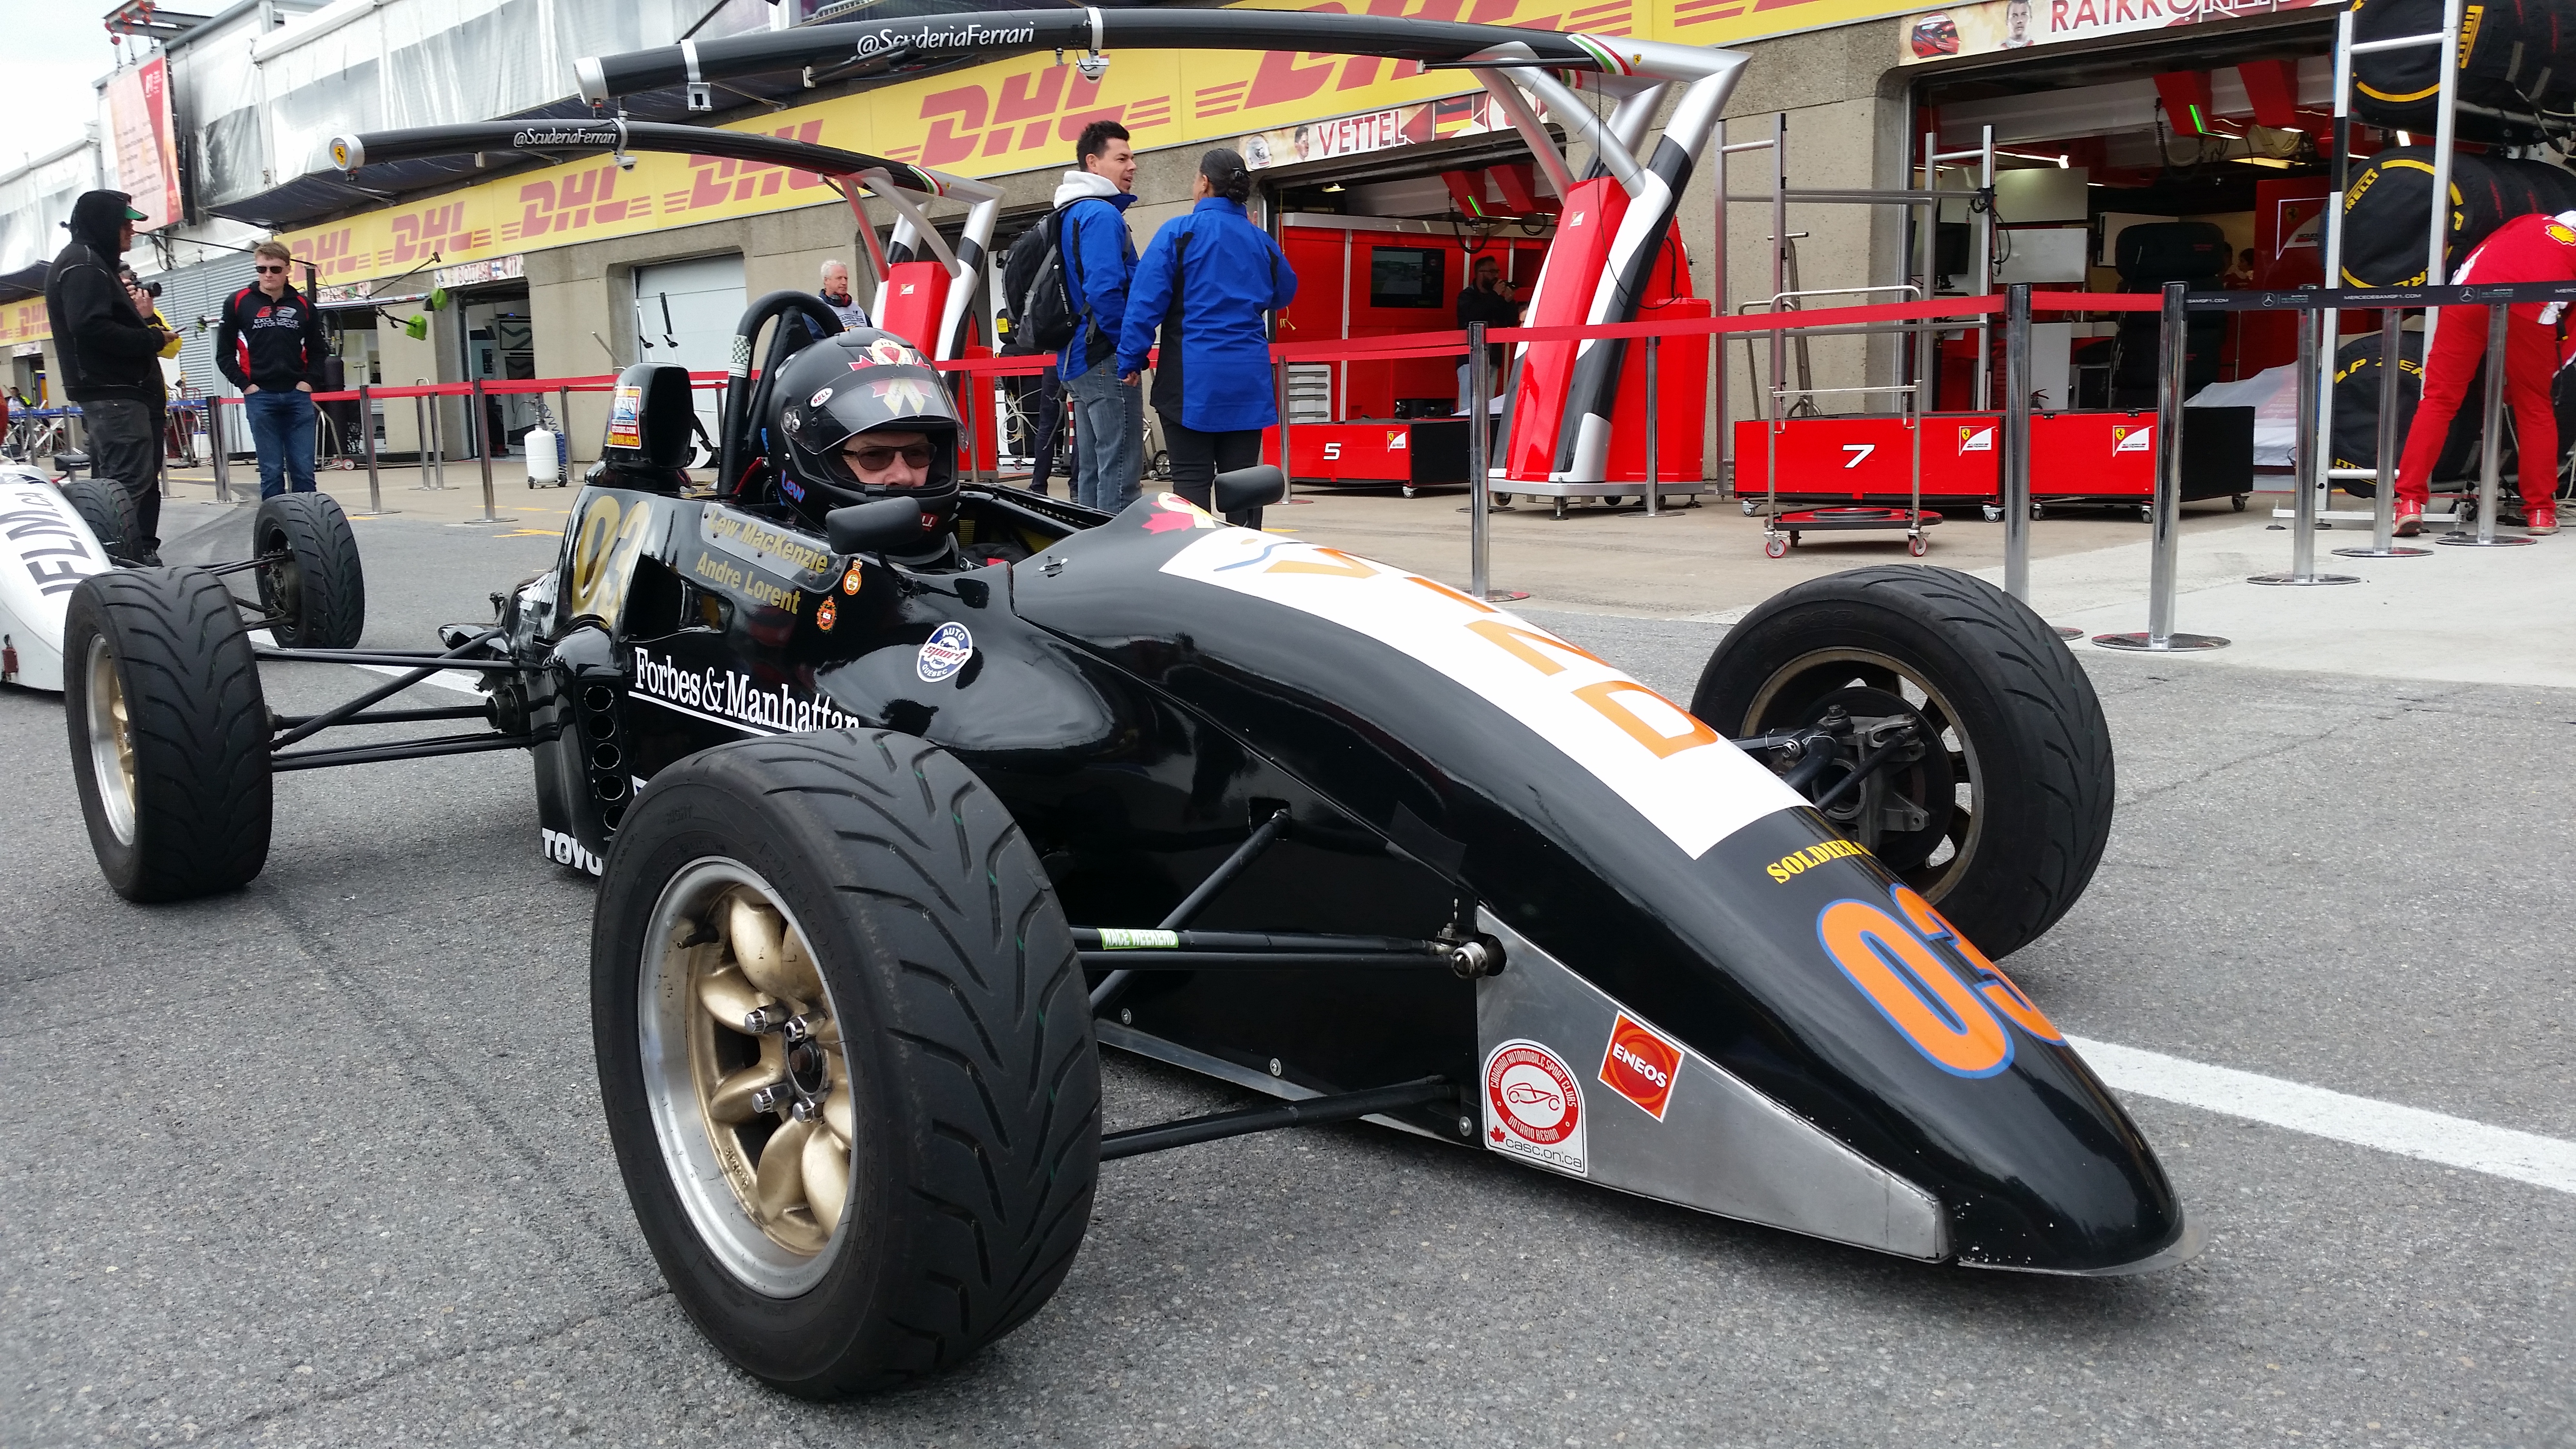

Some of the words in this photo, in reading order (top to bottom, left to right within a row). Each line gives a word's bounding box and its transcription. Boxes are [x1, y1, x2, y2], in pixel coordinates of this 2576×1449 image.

[857, 22, 1035, 56] @ScuderiaFerrari
[920, 54, 1126, 167] DHL
[513, 127, 617, 148] @ScuderiaFerrari
[1317, 108, 1408, 157] VETTEL
[520, 165, 629, 239] DHL
[391, 201, 472, 263] DHL
[292, 227, 358, 283] DHL
[18, 303, 52, 336] DHL
[252, 321, 300, 330] AUTOSPORT
[253, 317, 299, 325] EXCLUSIVE
[813, 390, 830, 404] BELL
[1323, 442, 1341, 460] 5
[1842, 444, 1875, 468] 7
[781, 469, 805, 503] Lew
[708, 509, 741, 538] Lew
[739, 521, 828, 573] MacKenzie
[572, 495, 649, 628] 03
[696, 552, 741, 590] Andre
[742, 570, 801, 614] Lorent
[942, 627, 966, 641] AUTO
[924, 646, 967, 661] sport
[1767, 839, 1862, 884] SOLDIER
[1101, 928, 1131, 947] RACE
[1127, 929, 1177, 946] WEEKEND
[1816, 883, 2067, 1079] 03
[1490, 1057, 1509, 1089] CANADIAN
[1506, 1049, 1546, 1068] AUTOMOBILE
[1561, 1078, 1578, 1108] CLUBS
[1613, 1042, 1667, 1088] ENEOS
[1508, 1115, 1534, 1139] ONTARIO
[1535, 1127, 1560, 1141] REGION
[1506, 1139, 1582, 1167] casc.on.ca
